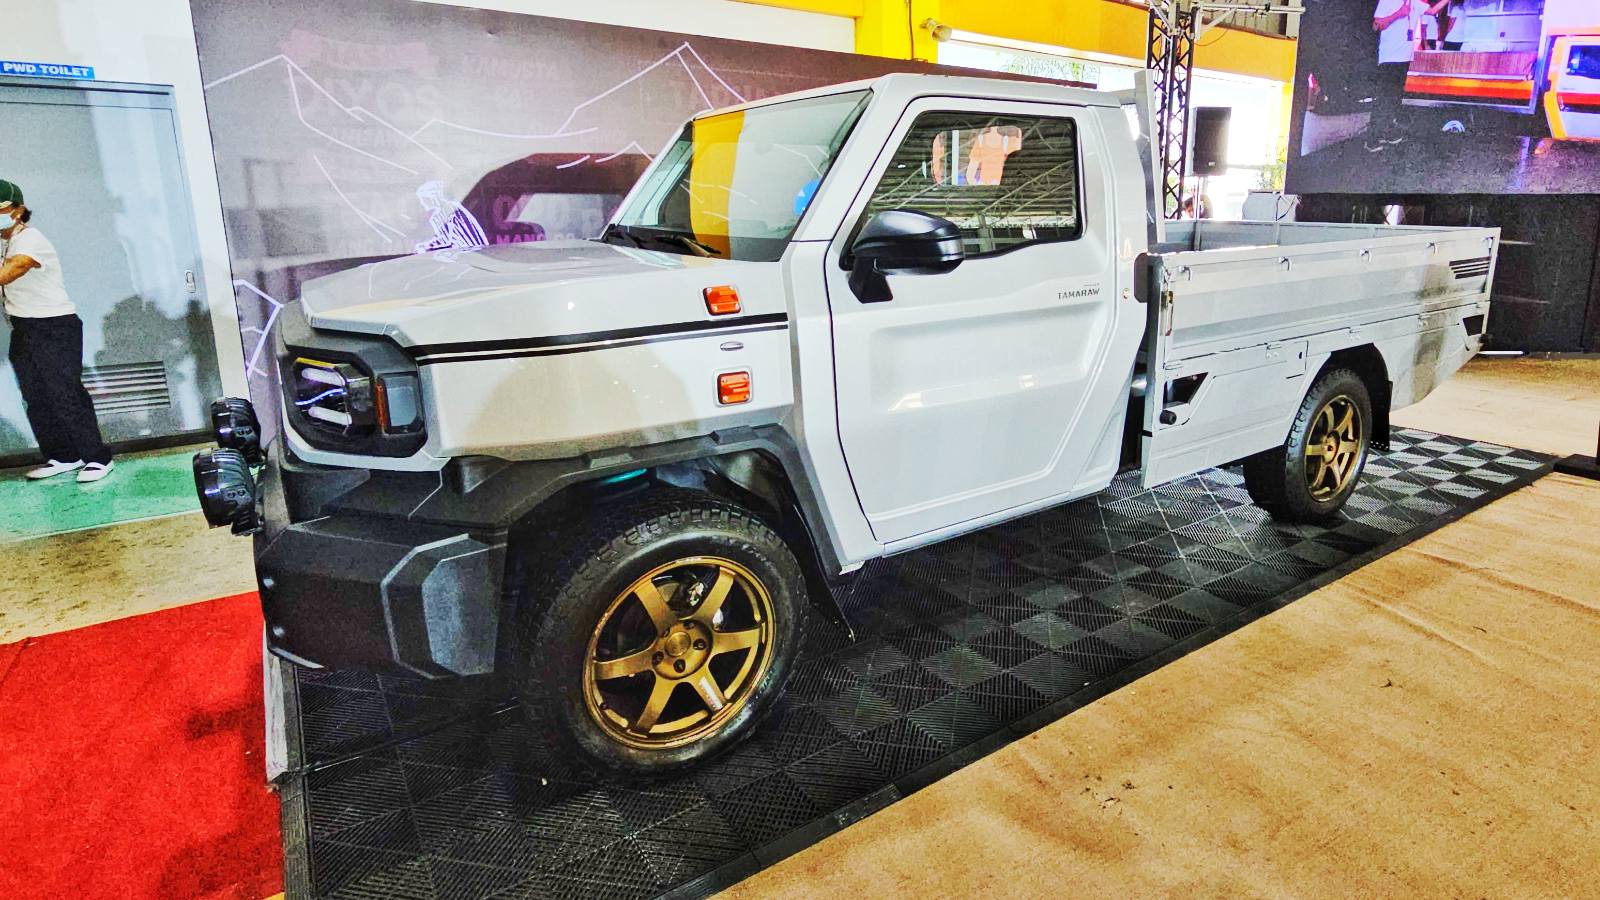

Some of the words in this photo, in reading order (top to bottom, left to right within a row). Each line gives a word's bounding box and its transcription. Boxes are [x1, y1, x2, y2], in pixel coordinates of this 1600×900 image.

[3, 62, 37, 73] PWD
[39, 65, 89, 76] TOILET
[1058, 288, 1100, 300] TAMARAW
